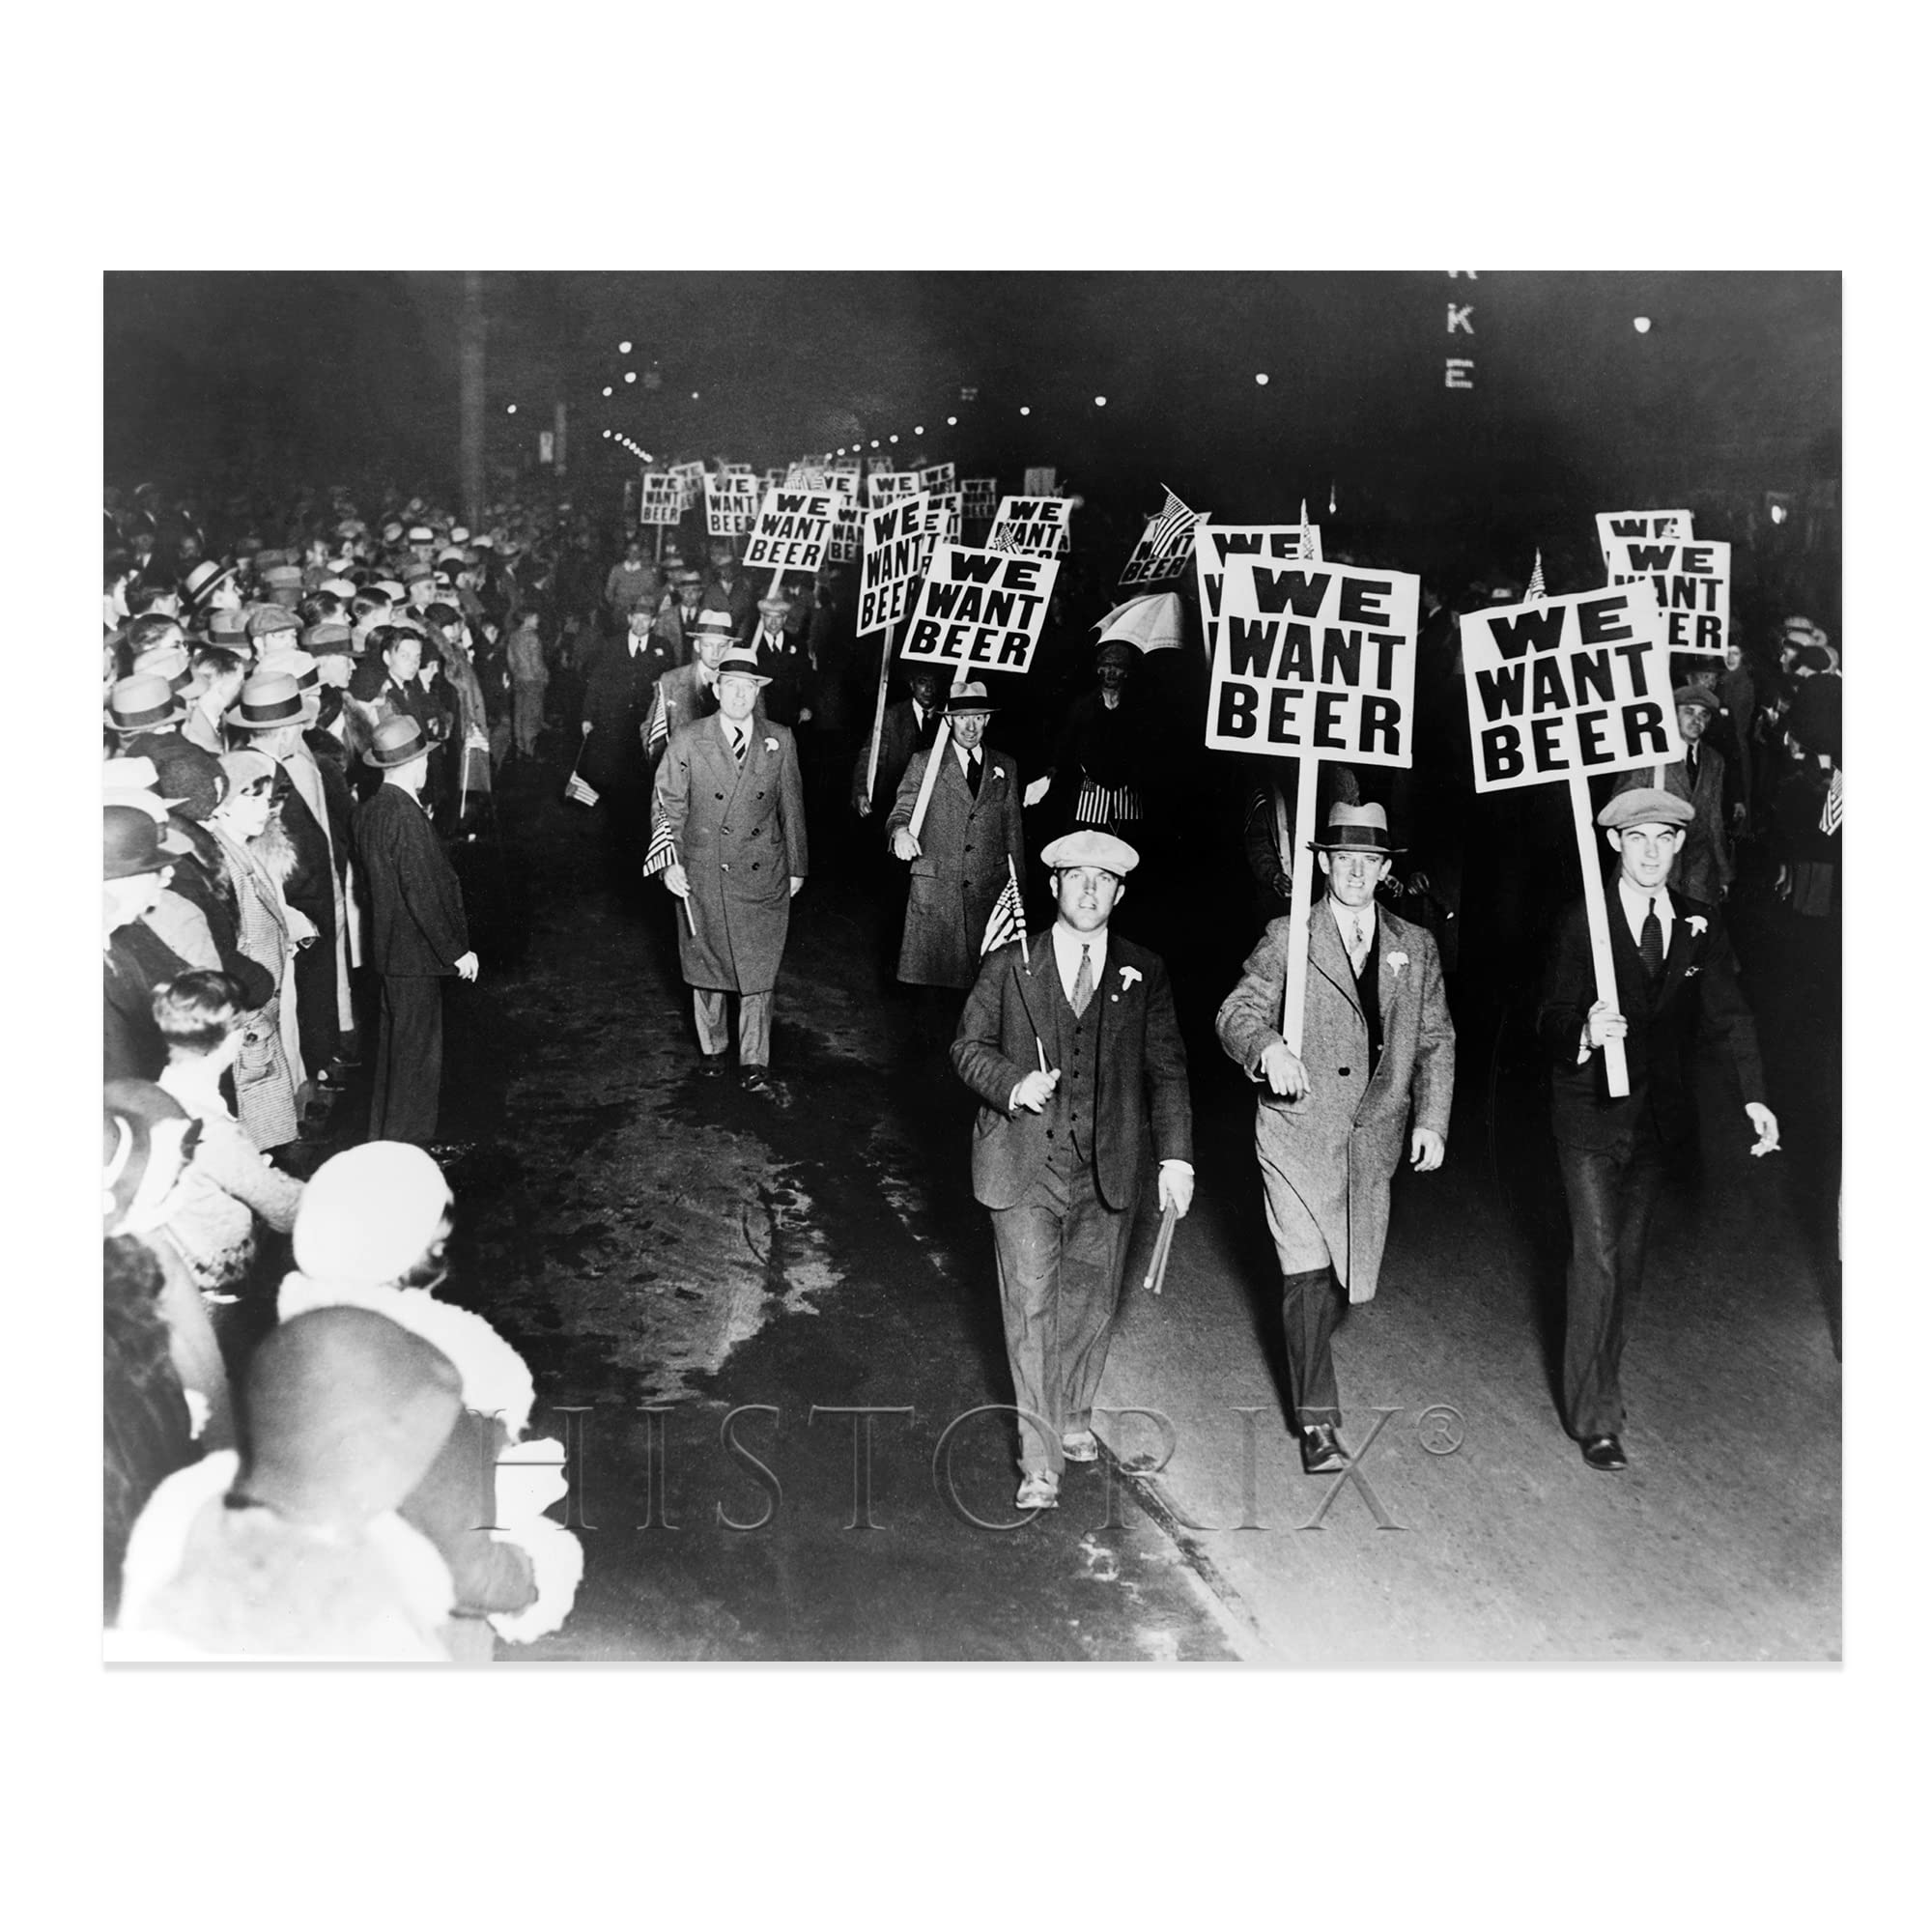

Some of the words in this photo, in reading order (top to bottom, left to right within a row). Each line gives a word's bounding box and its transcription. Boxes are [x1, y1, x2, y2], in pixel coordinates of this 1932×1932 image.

[651, 477, 677, 490] WE
[876, 476, 912, 492] WE
[643, 506, 678, 521] BEER
[710, 494, 753, 513] WANT
[777, 494, 831, 516] WE
[1010, 500, 1063, 522] WE
[761, 514, 831, 541] WANT
[873, 501, 920, 546] WE
[1609, 518, 1681, 539] WE
[749, 539, 820, 567] BEER
[831, 542, 856, 561] BE
[867, 533, 924, 589] WANT
[1134, 534, 1195, 560] WNT
[1211, 532, 1301, 568] WE
[1627, 544, 1715, 575] WE
[951, 551, 1042, 591] WE
[1122, 556, 1186, 582] BEER
[861, 574, 923, 630] BEER
[925, 582, 1044, 631] WANT
[1252, 565, 1393, 628] WE
[1614, 574, 1724, 612] ANT
[908, 618, 1031, 667] BEER
[1487, 595, 1634, 661] WE
[1667, 611, 1722, 649] ER
[1229, 615, 1406, 691] WANT
[1475, 641, 1654, 723] WANT
[1216, 681, 1402, 756] BEER
[1481, 701, 1670, 782] BEER
